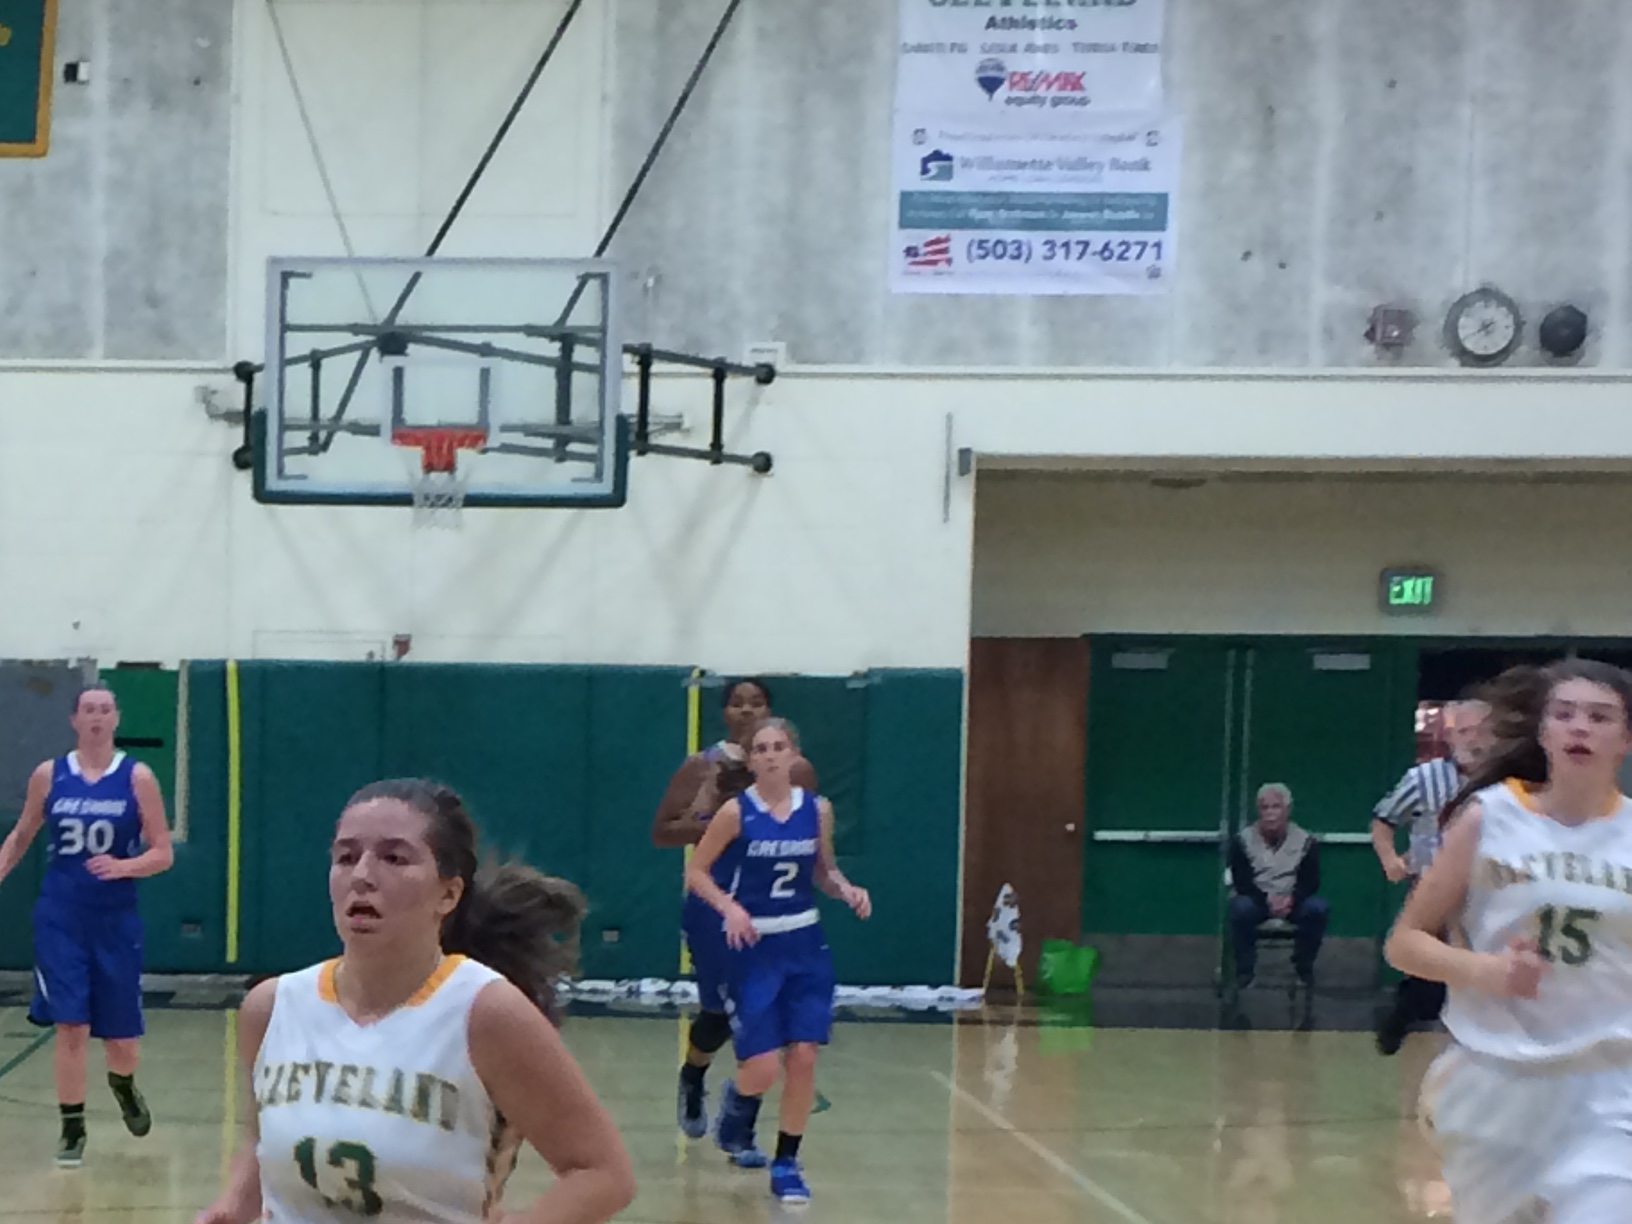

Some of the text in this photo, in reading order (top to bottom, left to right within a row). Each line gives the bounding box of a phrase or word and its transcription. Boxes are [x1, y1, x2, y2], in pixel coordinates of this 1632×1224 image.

[984, 15, 1078, 31] Athletics
[1007, 71, 1086, 92] RE/MAX
[967, 239, 1163, 263] (503) 317-6271
[1389, 576, 1434, 605] EXIT
[58, 818, 115, 855] 30
[770, 862, 800, 899] 2
[1537, 903, 1603, 966] 15
[293, 1137, 383, 1216] 13
